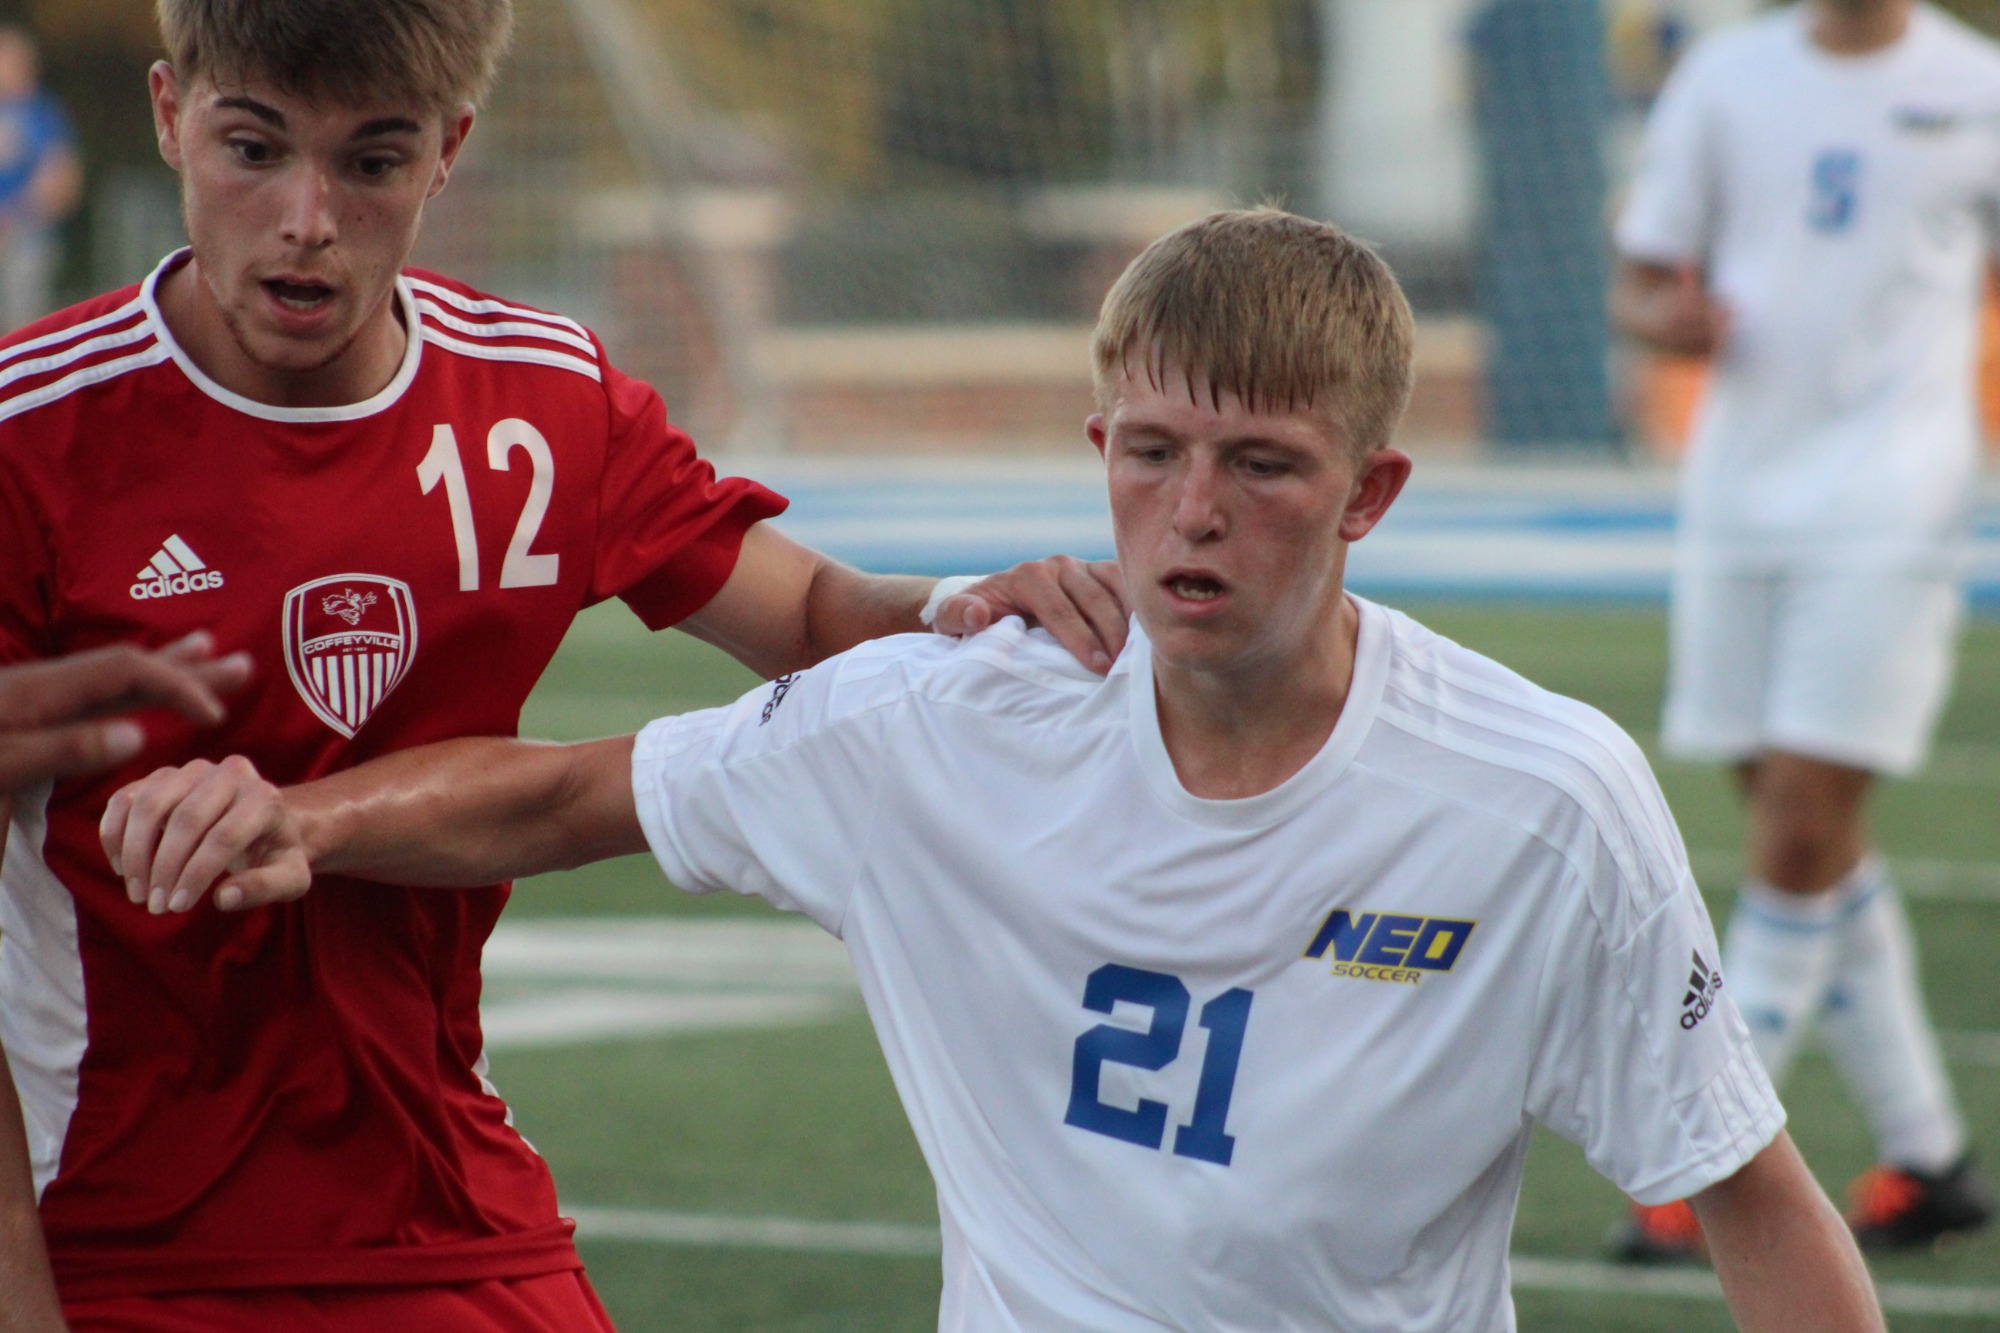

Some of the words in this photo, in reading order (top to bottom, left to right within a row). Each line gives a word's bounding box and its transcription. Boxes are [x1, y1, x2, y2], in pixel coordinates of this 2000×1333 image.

[416, 417, 560, 592] 12
[129, 570, 224, 600] adidas
[302, 635, 400, 655] COFFEYVILLE
[1301, 908, 1478, 972] NEO
[1332, 963, 1422, 984] SOCCER
[1063, 962, 1255, 1167] 21
